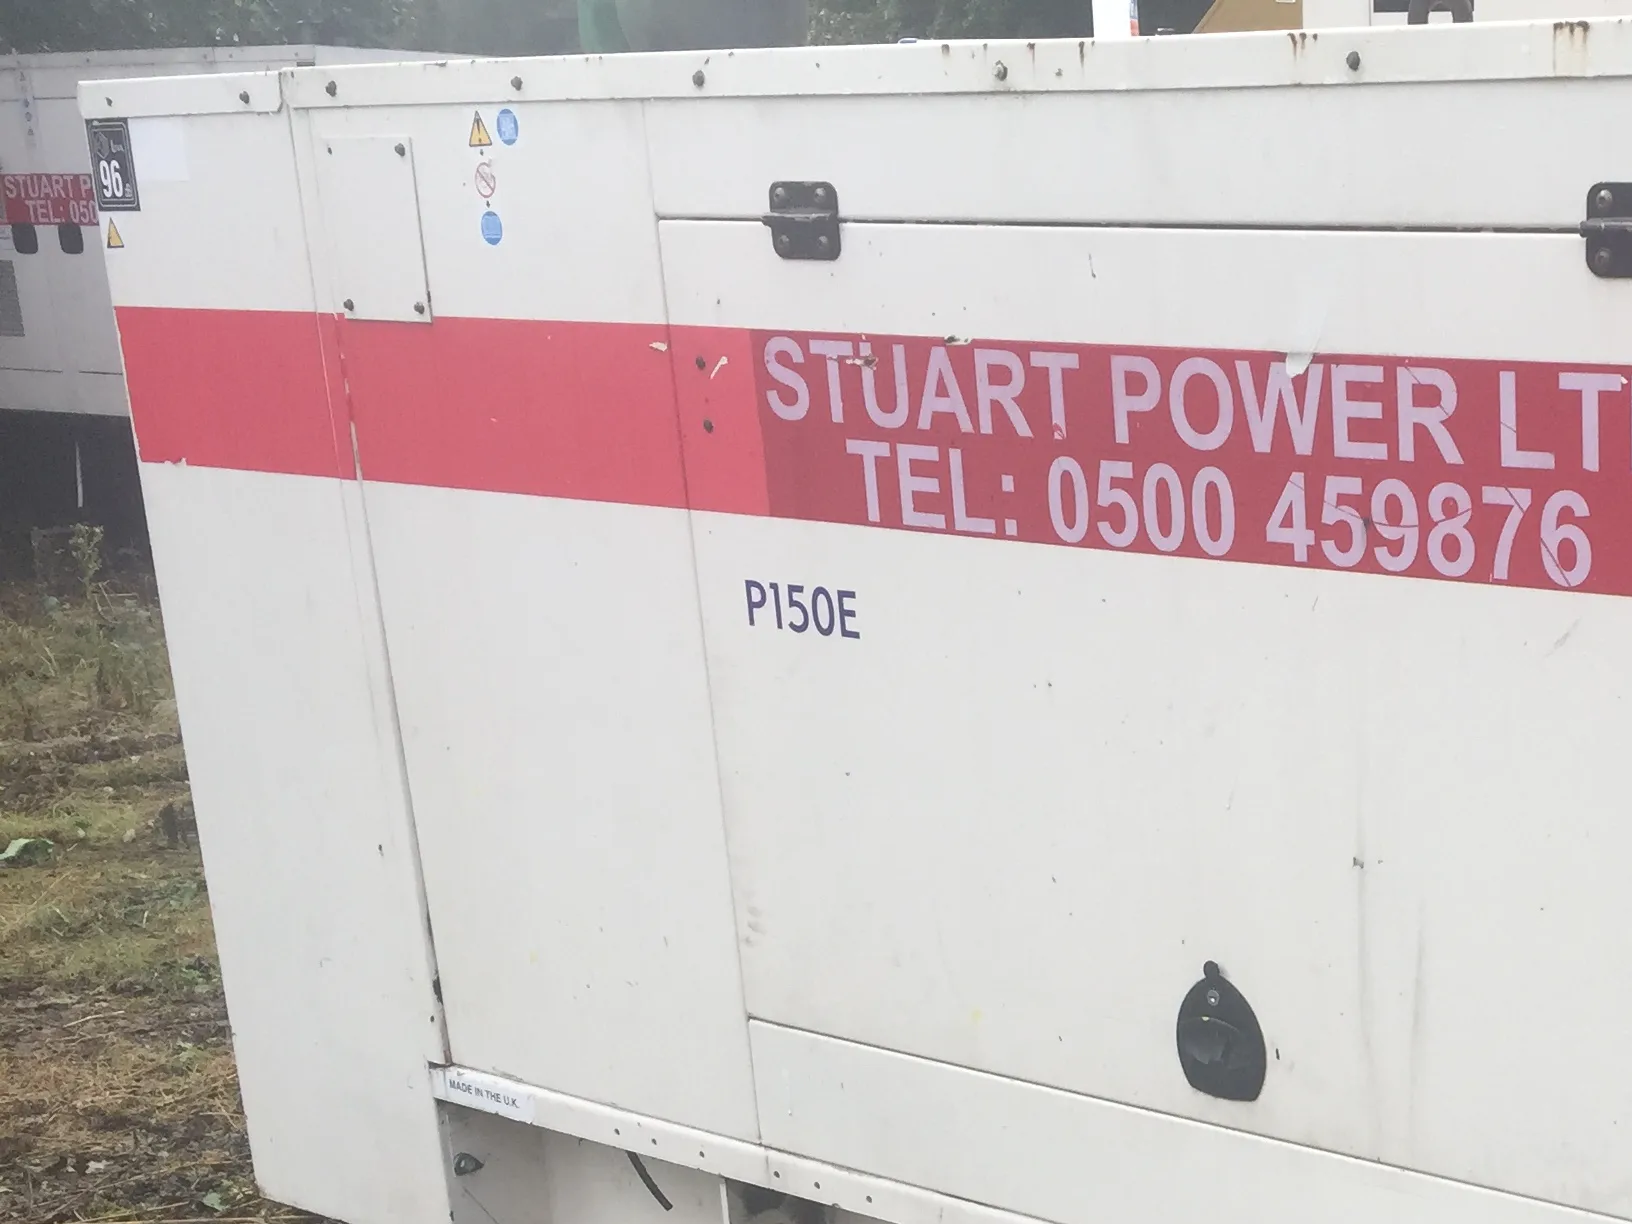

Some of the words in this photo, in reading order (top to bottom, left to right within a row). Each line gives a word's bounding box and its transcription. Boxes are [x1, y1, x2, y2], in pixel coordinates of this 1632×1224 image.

[4, 175, 74, 198] STUART
[99, 160, 124, 198] 96
[25, 200, 66, 223] TEL:
[763, 336, 1080, 440] STUART
[1110, 354, 1465, 465] POWER
[845, 438, 1018, 537] TEL:
[1047, 455, 1236, 557] 0500
[1265, 471, 1593, 588] 459876
[744, 579, 861, 640] P150E
[449, 1079, 473, 1095] MADE
[474, 1086, 484, 1097] IN
[485, 1089, 501, 1103] THE
